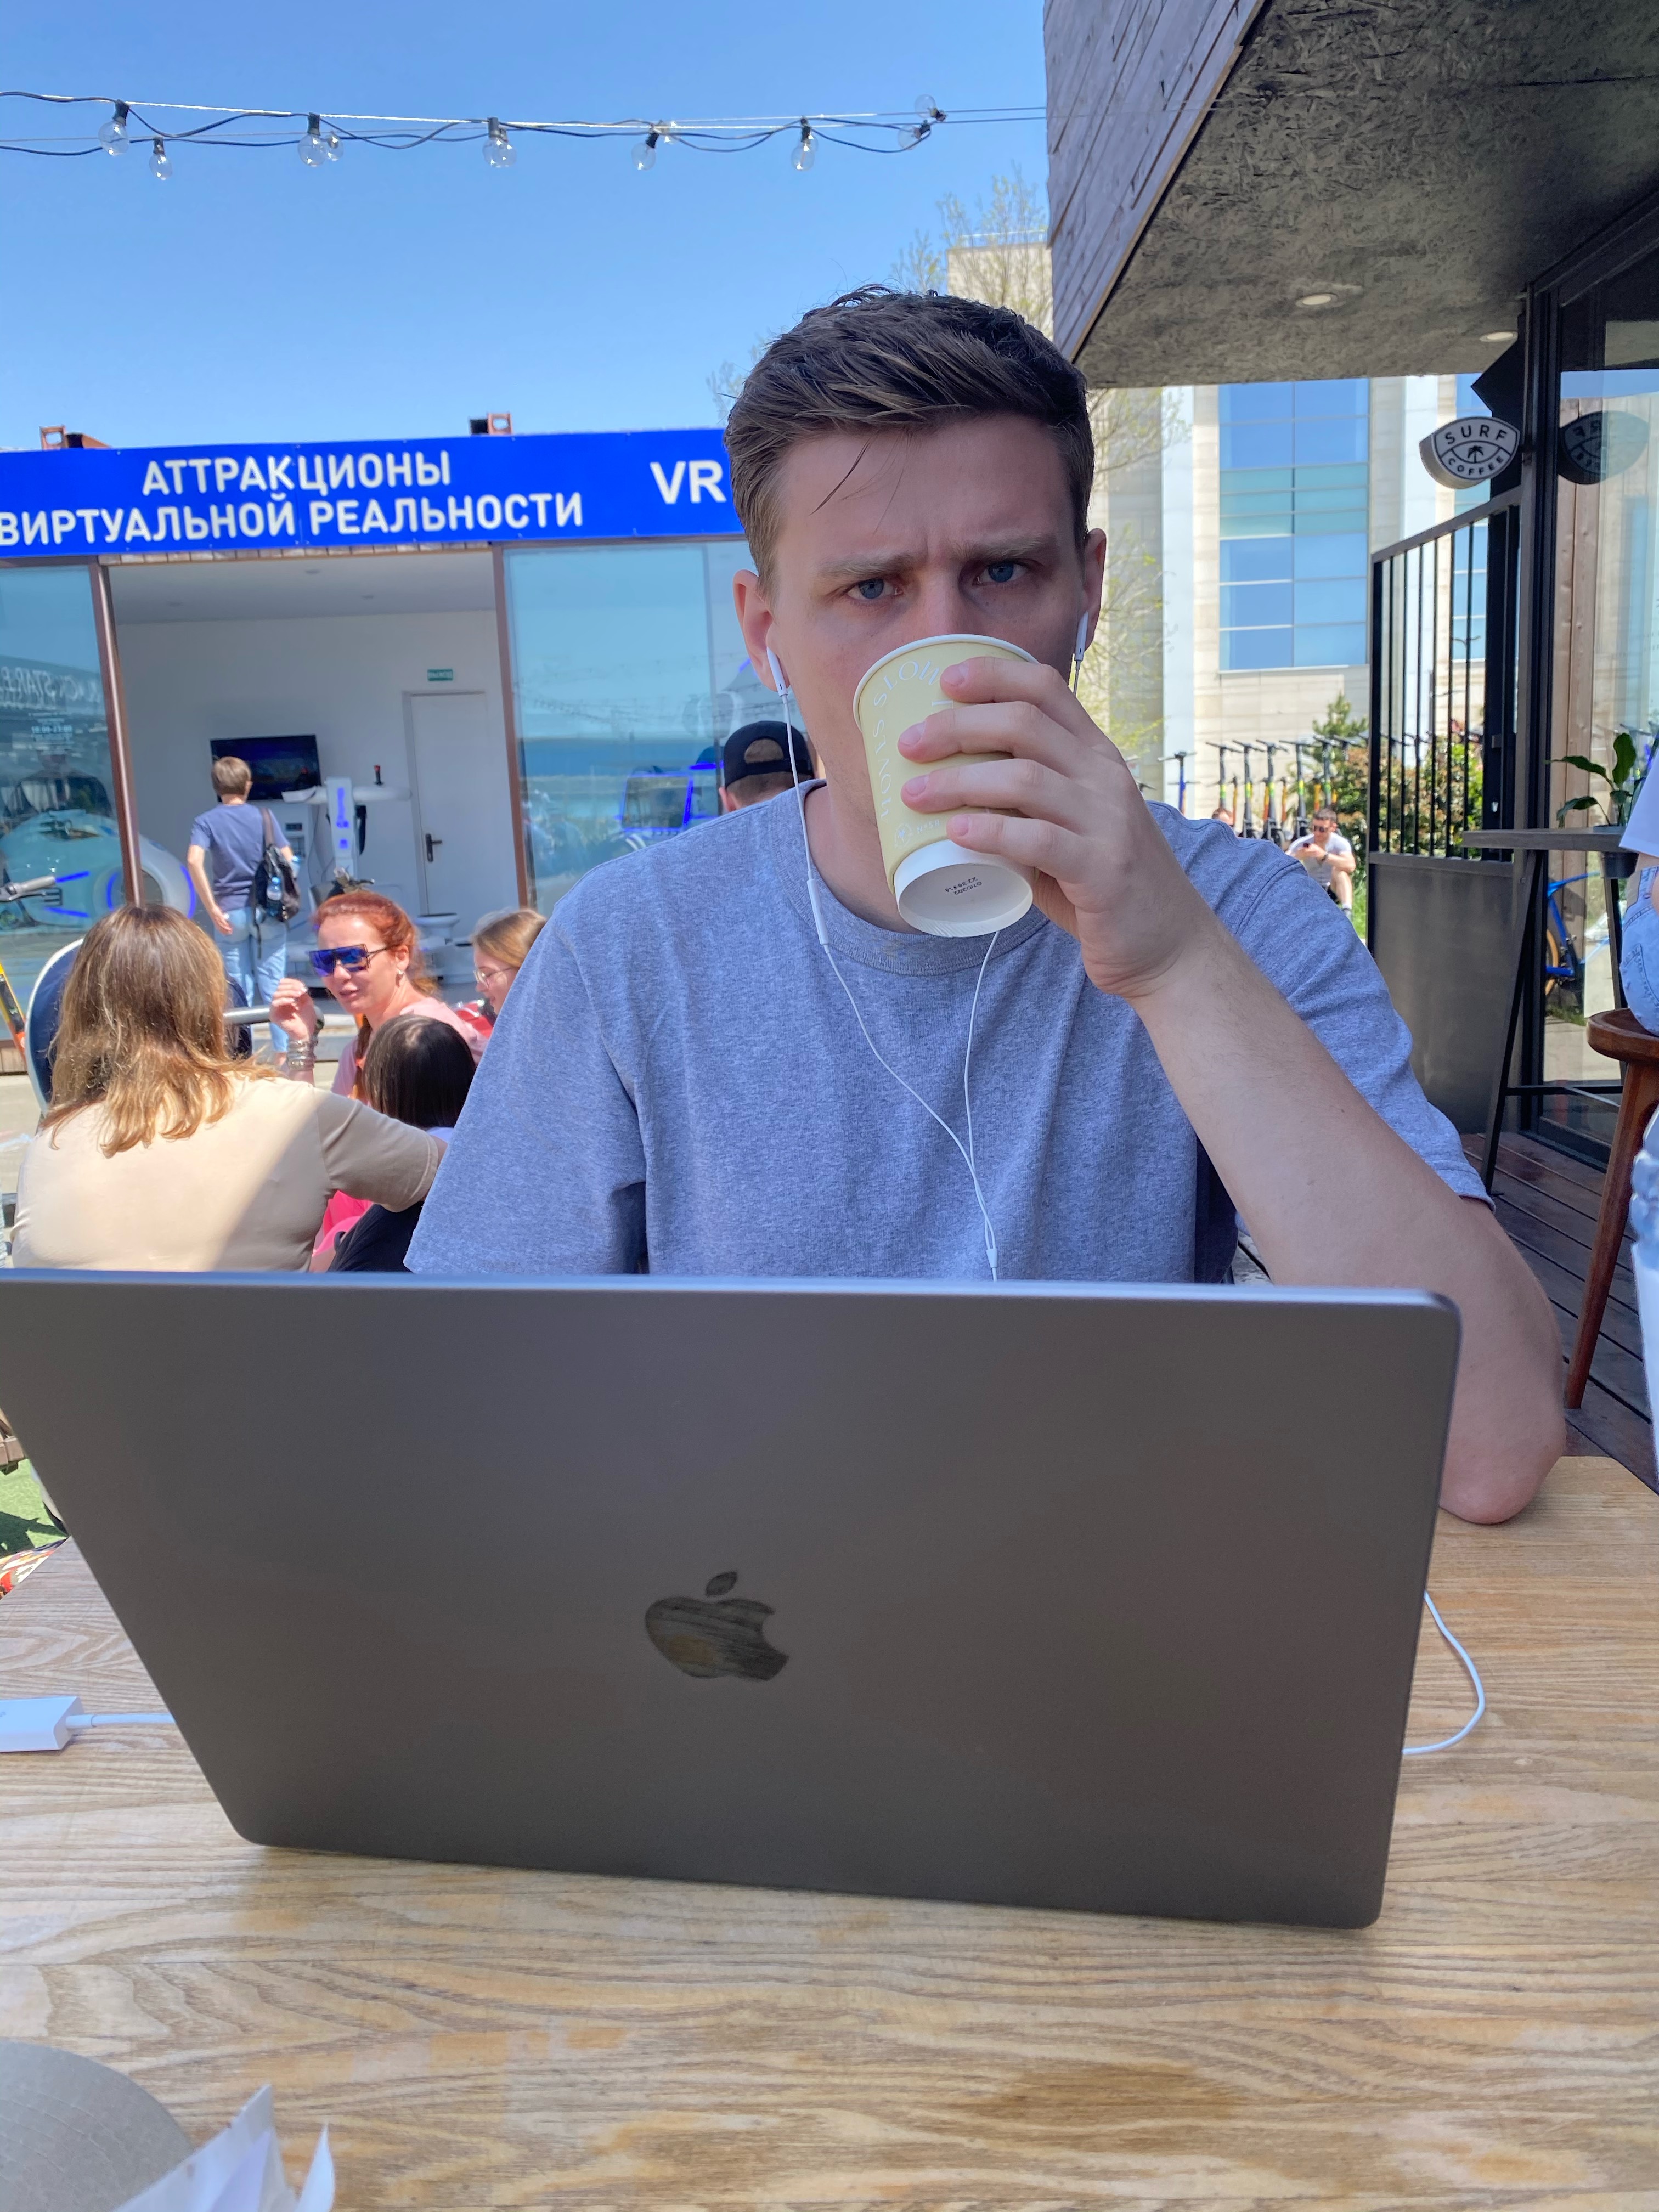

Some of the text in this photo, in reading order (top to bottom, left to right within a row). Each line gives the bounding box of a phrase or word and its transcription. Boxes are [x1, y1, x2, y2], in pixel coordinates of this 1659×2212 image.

[1444, 424, 1507, 445] SURF
[143, 451, 450, 496] АТТРАКЦИОНЫ
[650, 460, 726, 504] VR
[1448, 457, 1504, 476] COFFEE
[0, 492, 582, 545] ВИРТУАЛЬНОЙ РЕАЛЬНОСТИ
[873, 660, 940, 707] SLOW
